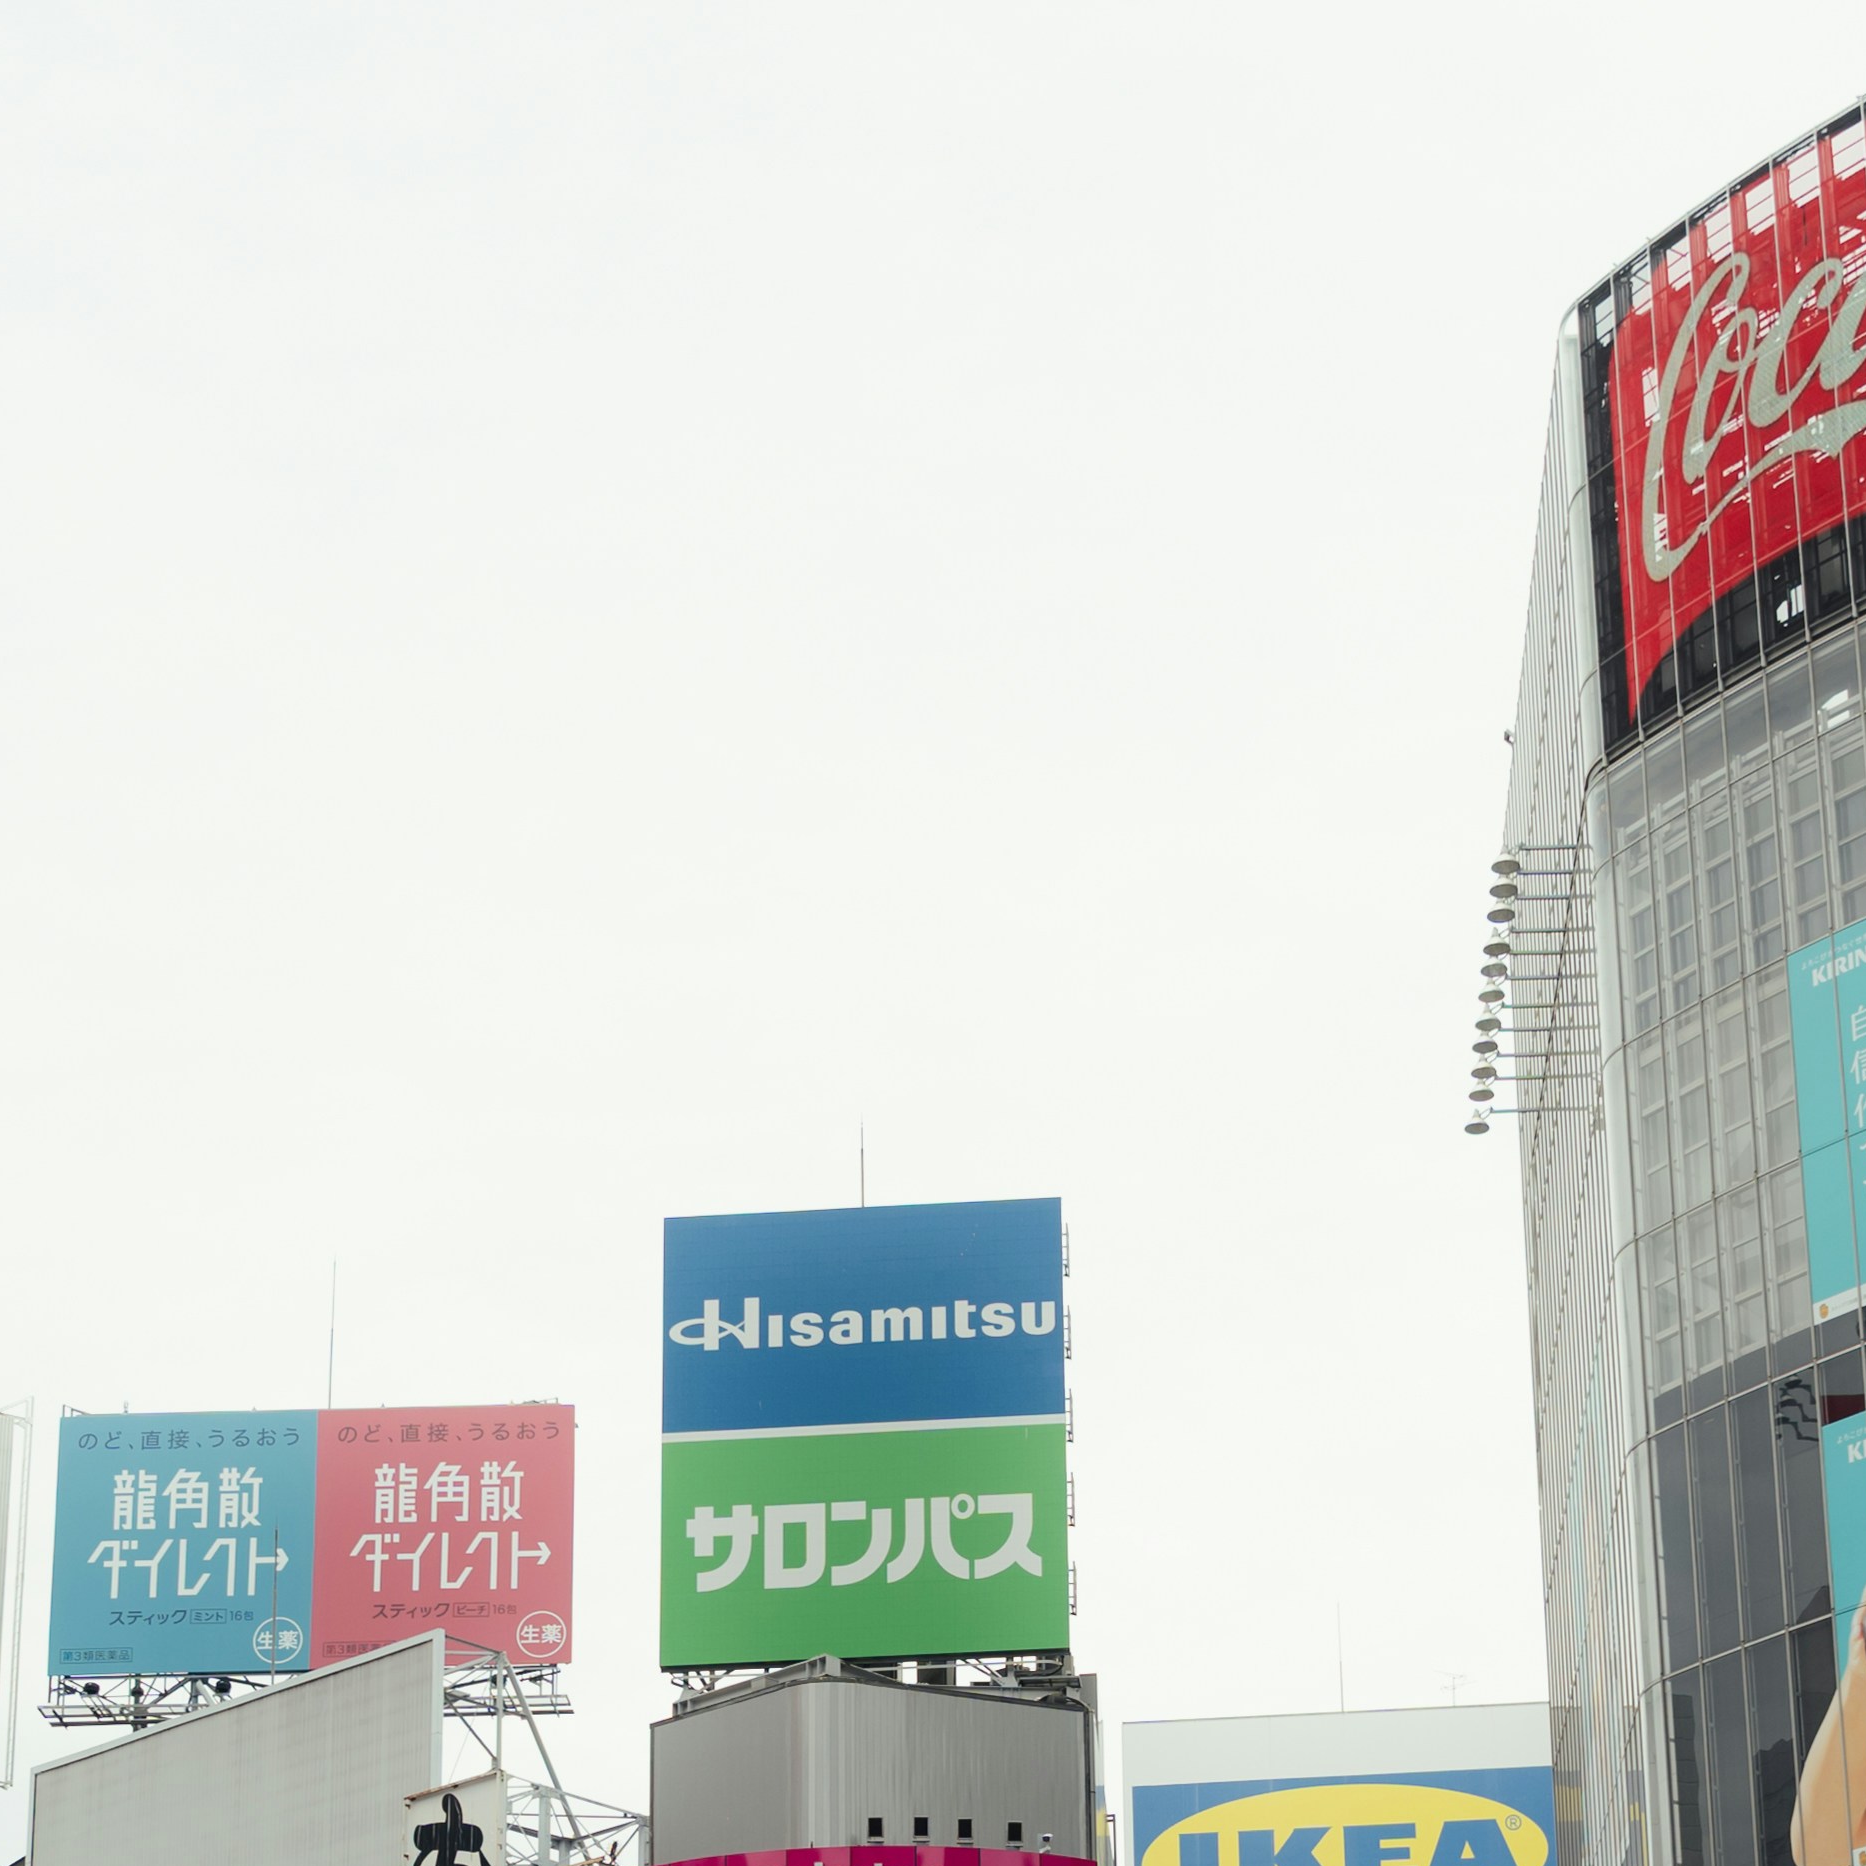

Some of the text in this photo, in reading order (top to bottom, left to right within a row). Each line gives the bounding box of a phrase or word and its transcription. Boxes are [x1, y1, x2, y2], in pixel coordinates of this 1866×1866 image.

[669, 1296, 1057, 1352] Hisamitsu
[78, 1426, 301, 1452] のど、直接、うるおう
[338, 1420, 561, 1445] のど、直接、うるおう
[113, 1466, 264, 1531] 龍角散
[374, 1460, 525, 1524] 龍角散
[686, 1493, 1043, 1593] サロンパス
[87, 1536, 290, 1600] ダイレクト
[349, 1530, 551, 1593] ダイレクト
[108, 1607, 254, 1627] スティック ミント 16包
[371, 1601, 517, 1620] スティック ピーチ 16包
[258, 1628, 299, 1651] 生薬
[521, 1624, 563, 1646] 生薬
[62, 1649, 132, 1664] 第3類医薬品
